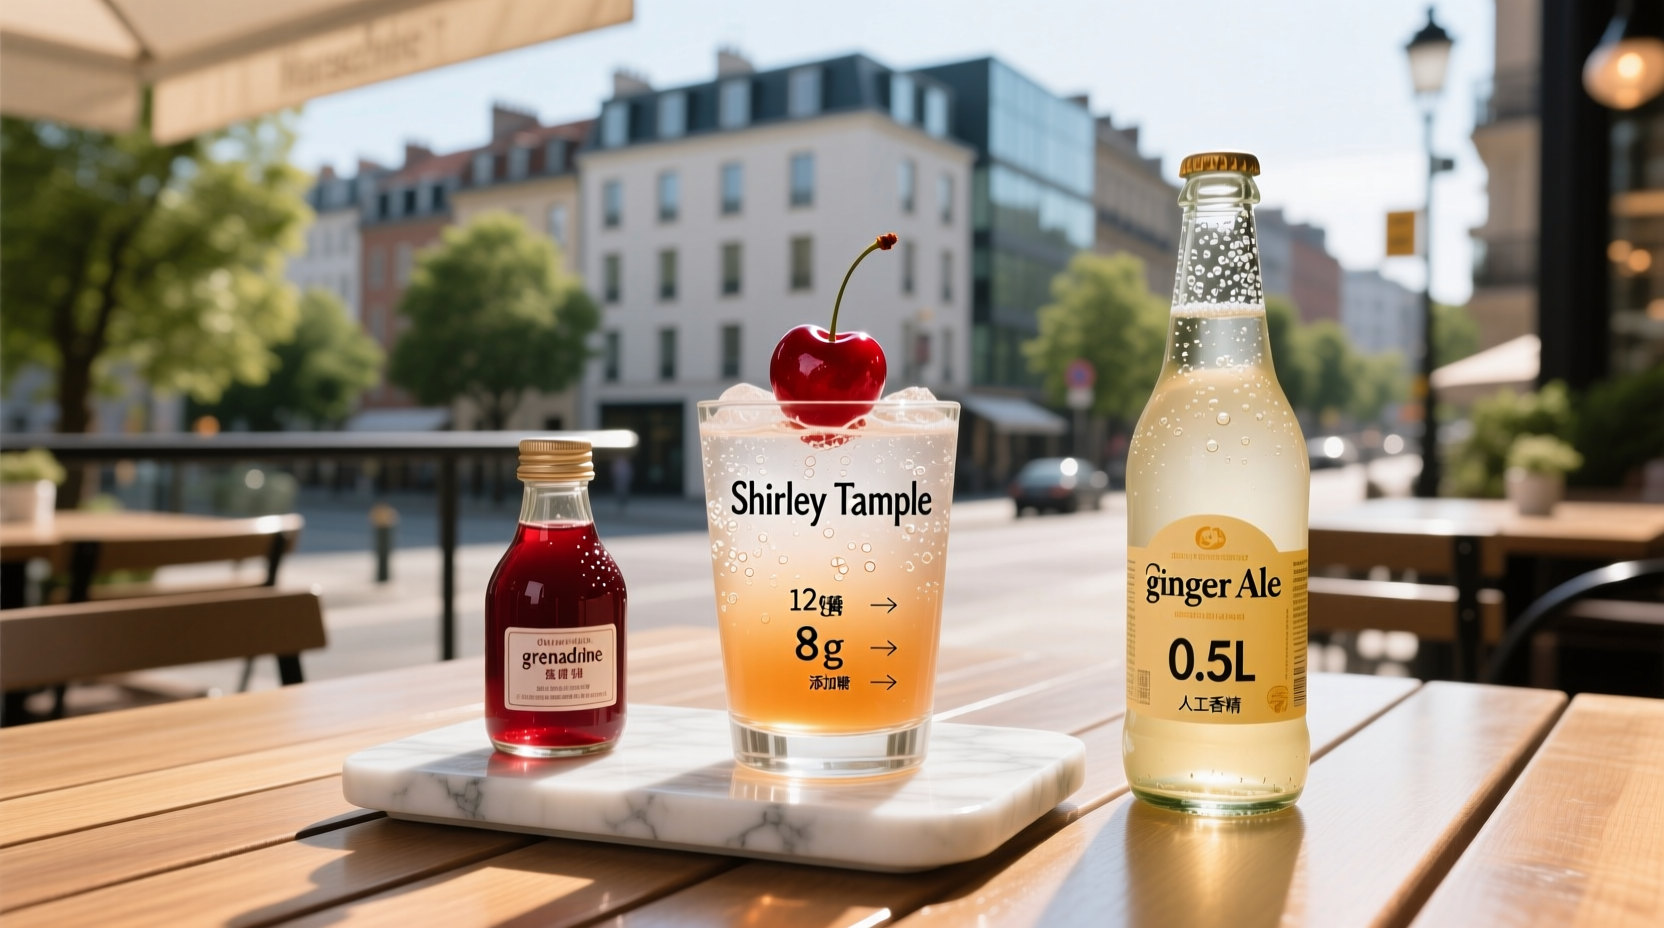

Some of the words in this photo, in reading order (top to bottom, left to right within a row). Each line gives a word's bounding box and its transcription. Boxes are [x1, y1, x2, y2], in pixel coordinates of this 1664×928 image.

[731, 480, 827, 527] Shirley
[833, 480, 932, 527] Tample
[1235, 566, 1281, 599] Ale
[795, 625, 844, 670] 8g
[1168, 637, 1256, 682] 0.5L
[1178, 695, 1241, 714] 人工香精
